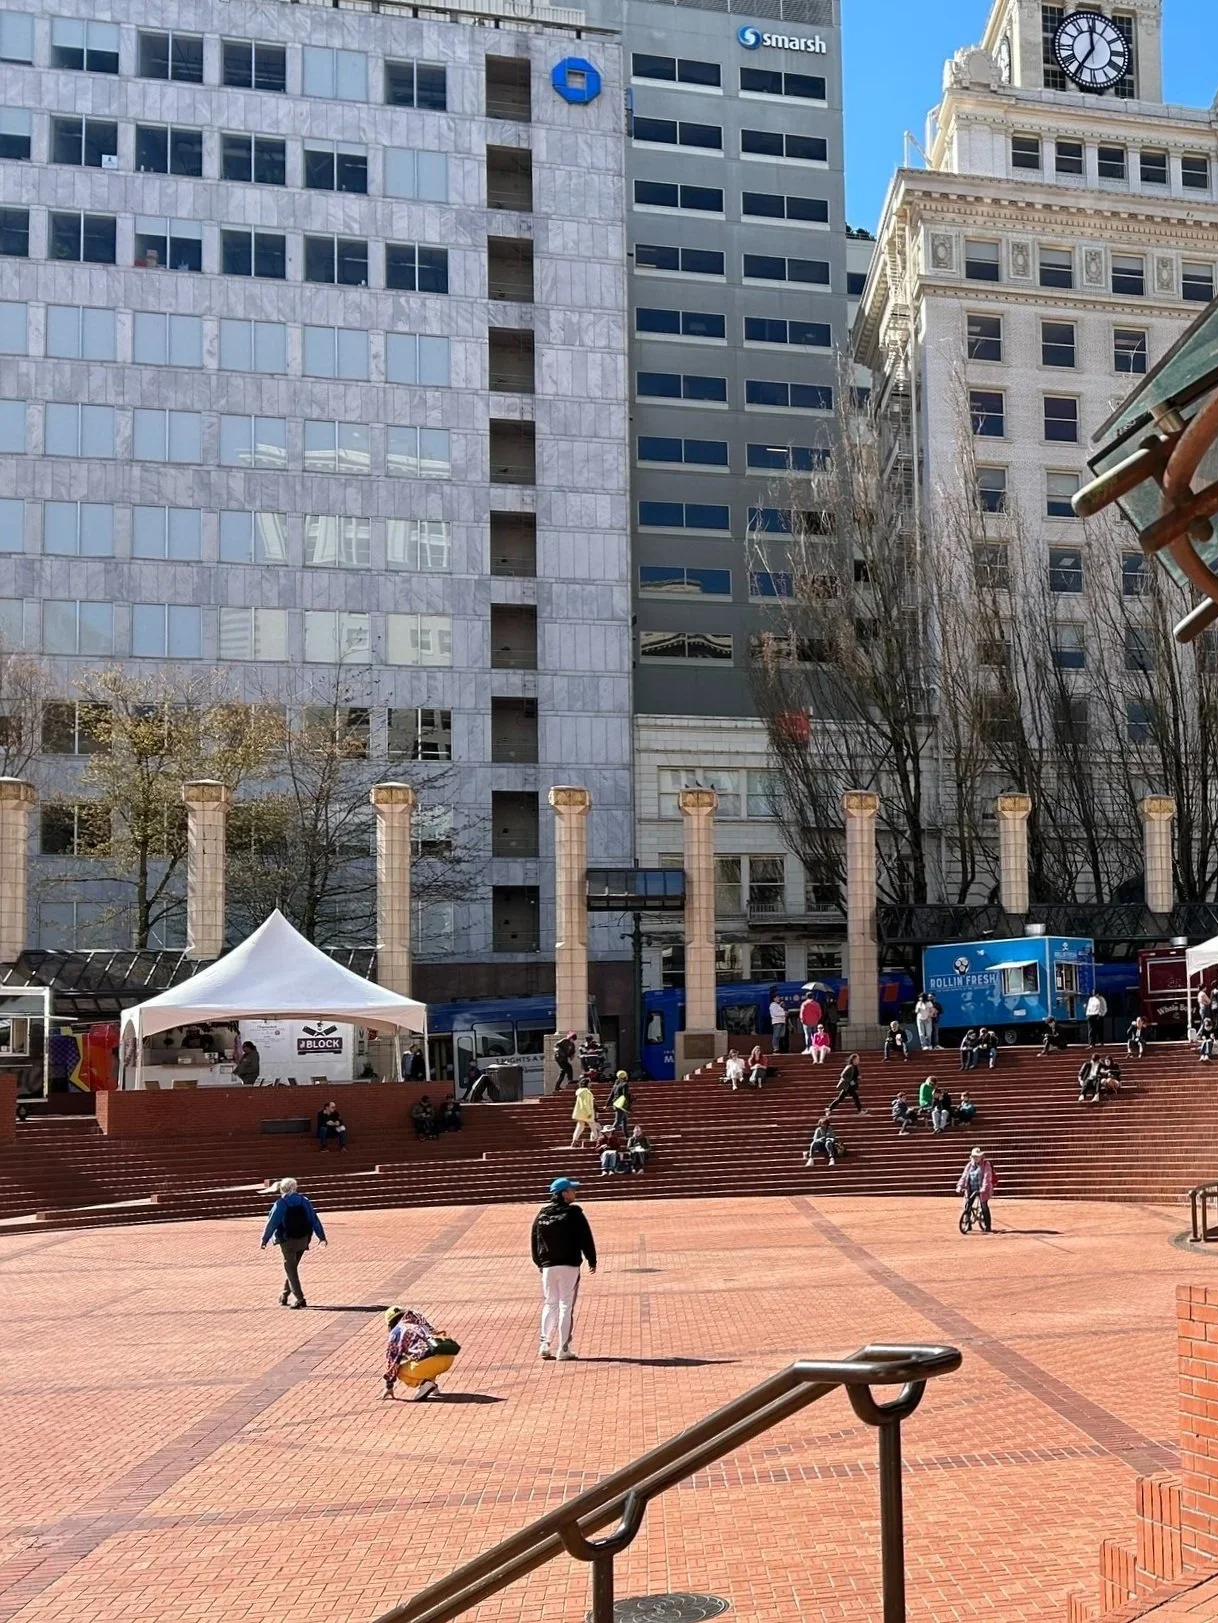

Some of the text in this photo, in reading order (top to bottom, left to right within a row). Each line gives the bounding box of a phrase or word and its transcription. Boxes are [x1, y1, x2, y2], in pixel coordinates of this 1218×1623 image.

[762, 33, 827, 54] smarsh
[930, 974, 995, 987] ROLLIN FRESH
[1157, 1003, 1197, 1015] Whole Bol
[306, 1040, 339, 1048] BLOCK
